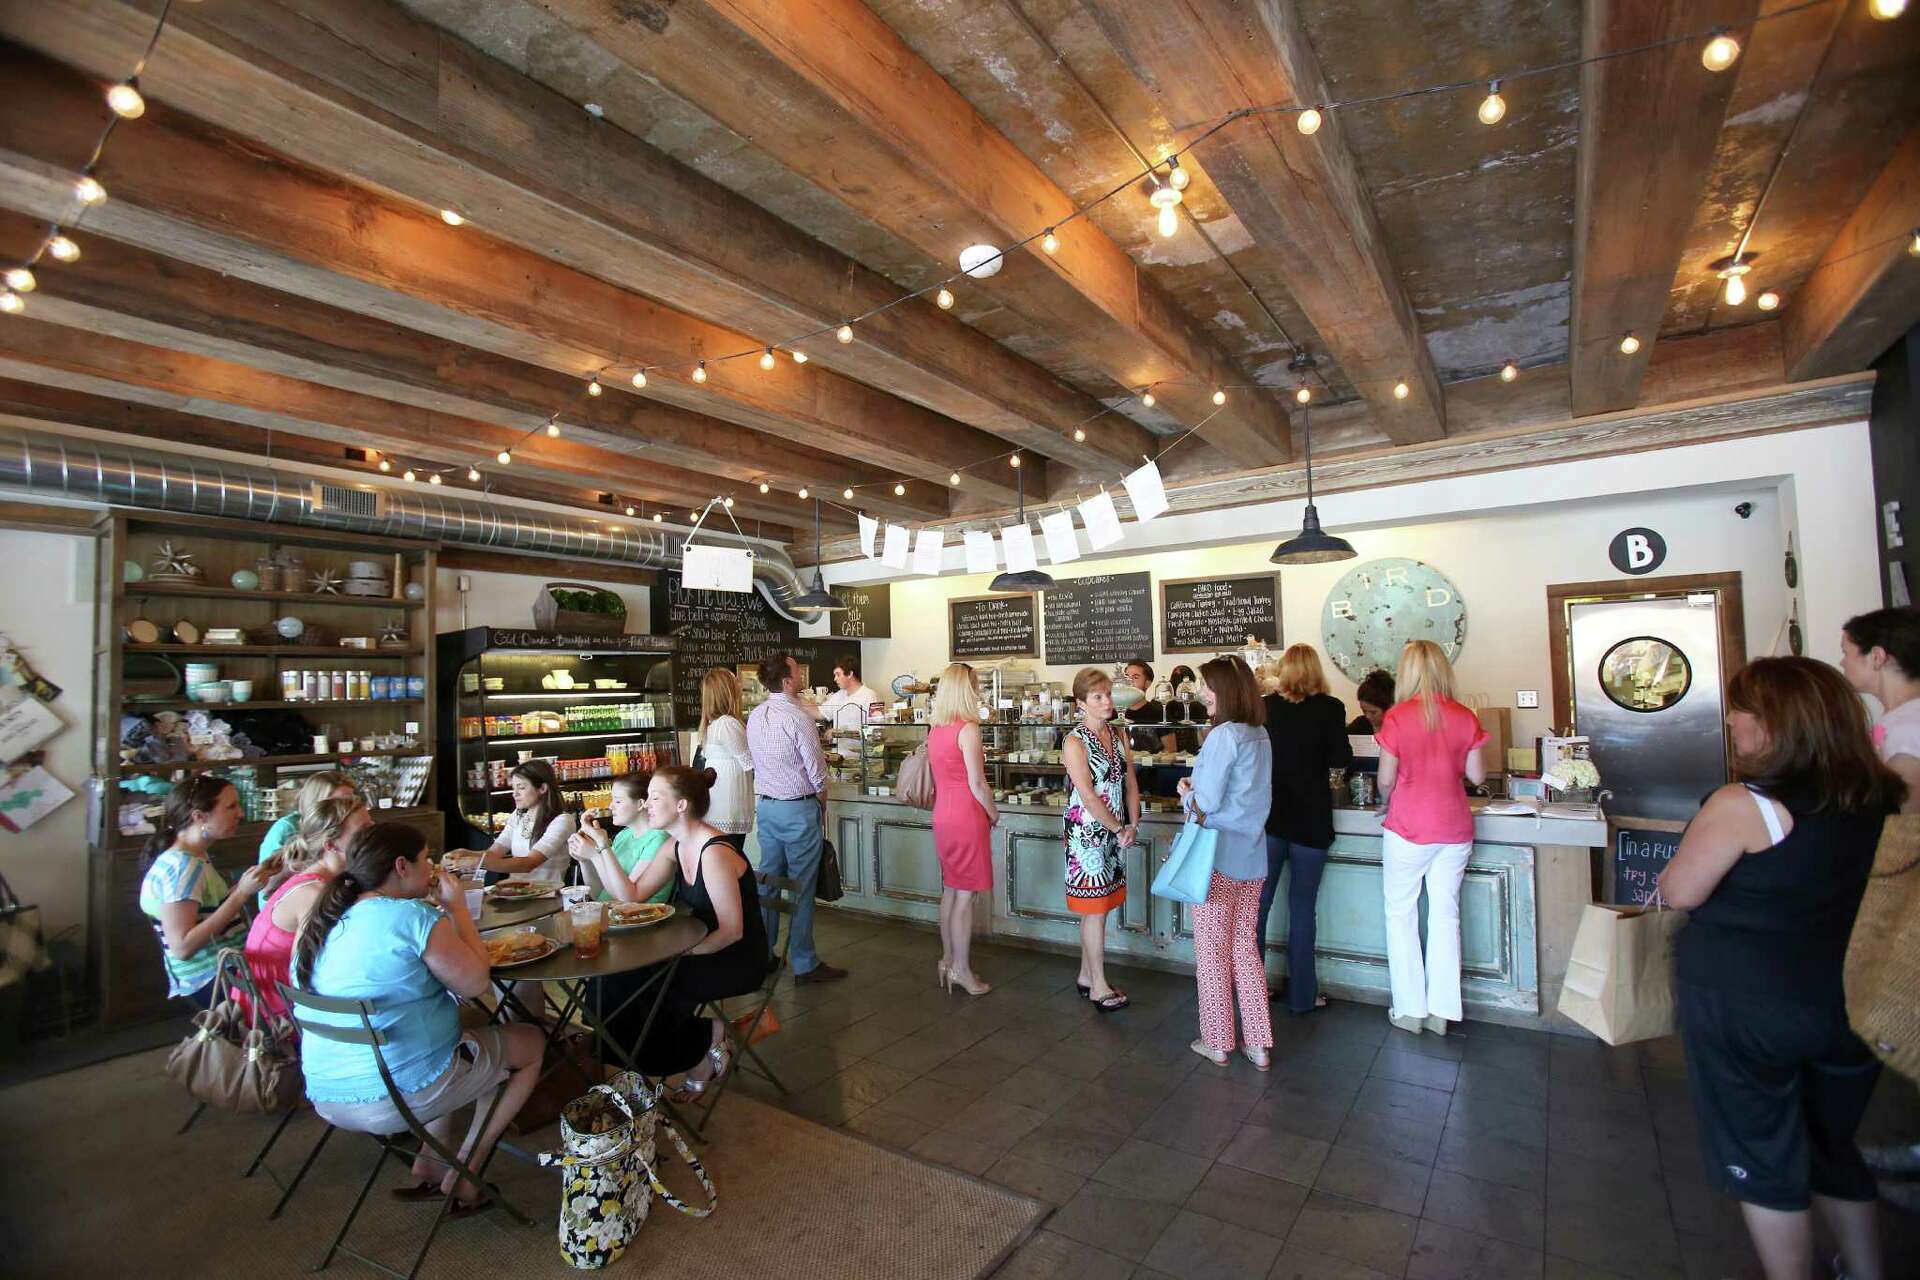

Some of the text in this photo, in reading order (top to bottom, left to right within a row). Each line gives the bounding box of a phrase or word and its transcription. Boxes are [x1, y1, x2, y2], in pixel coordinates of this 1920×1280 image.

[1626, 534, 1654, 569] B
[1331, 567, 1451, 618] BIRD
[1641, 843, 1650, 857] a
